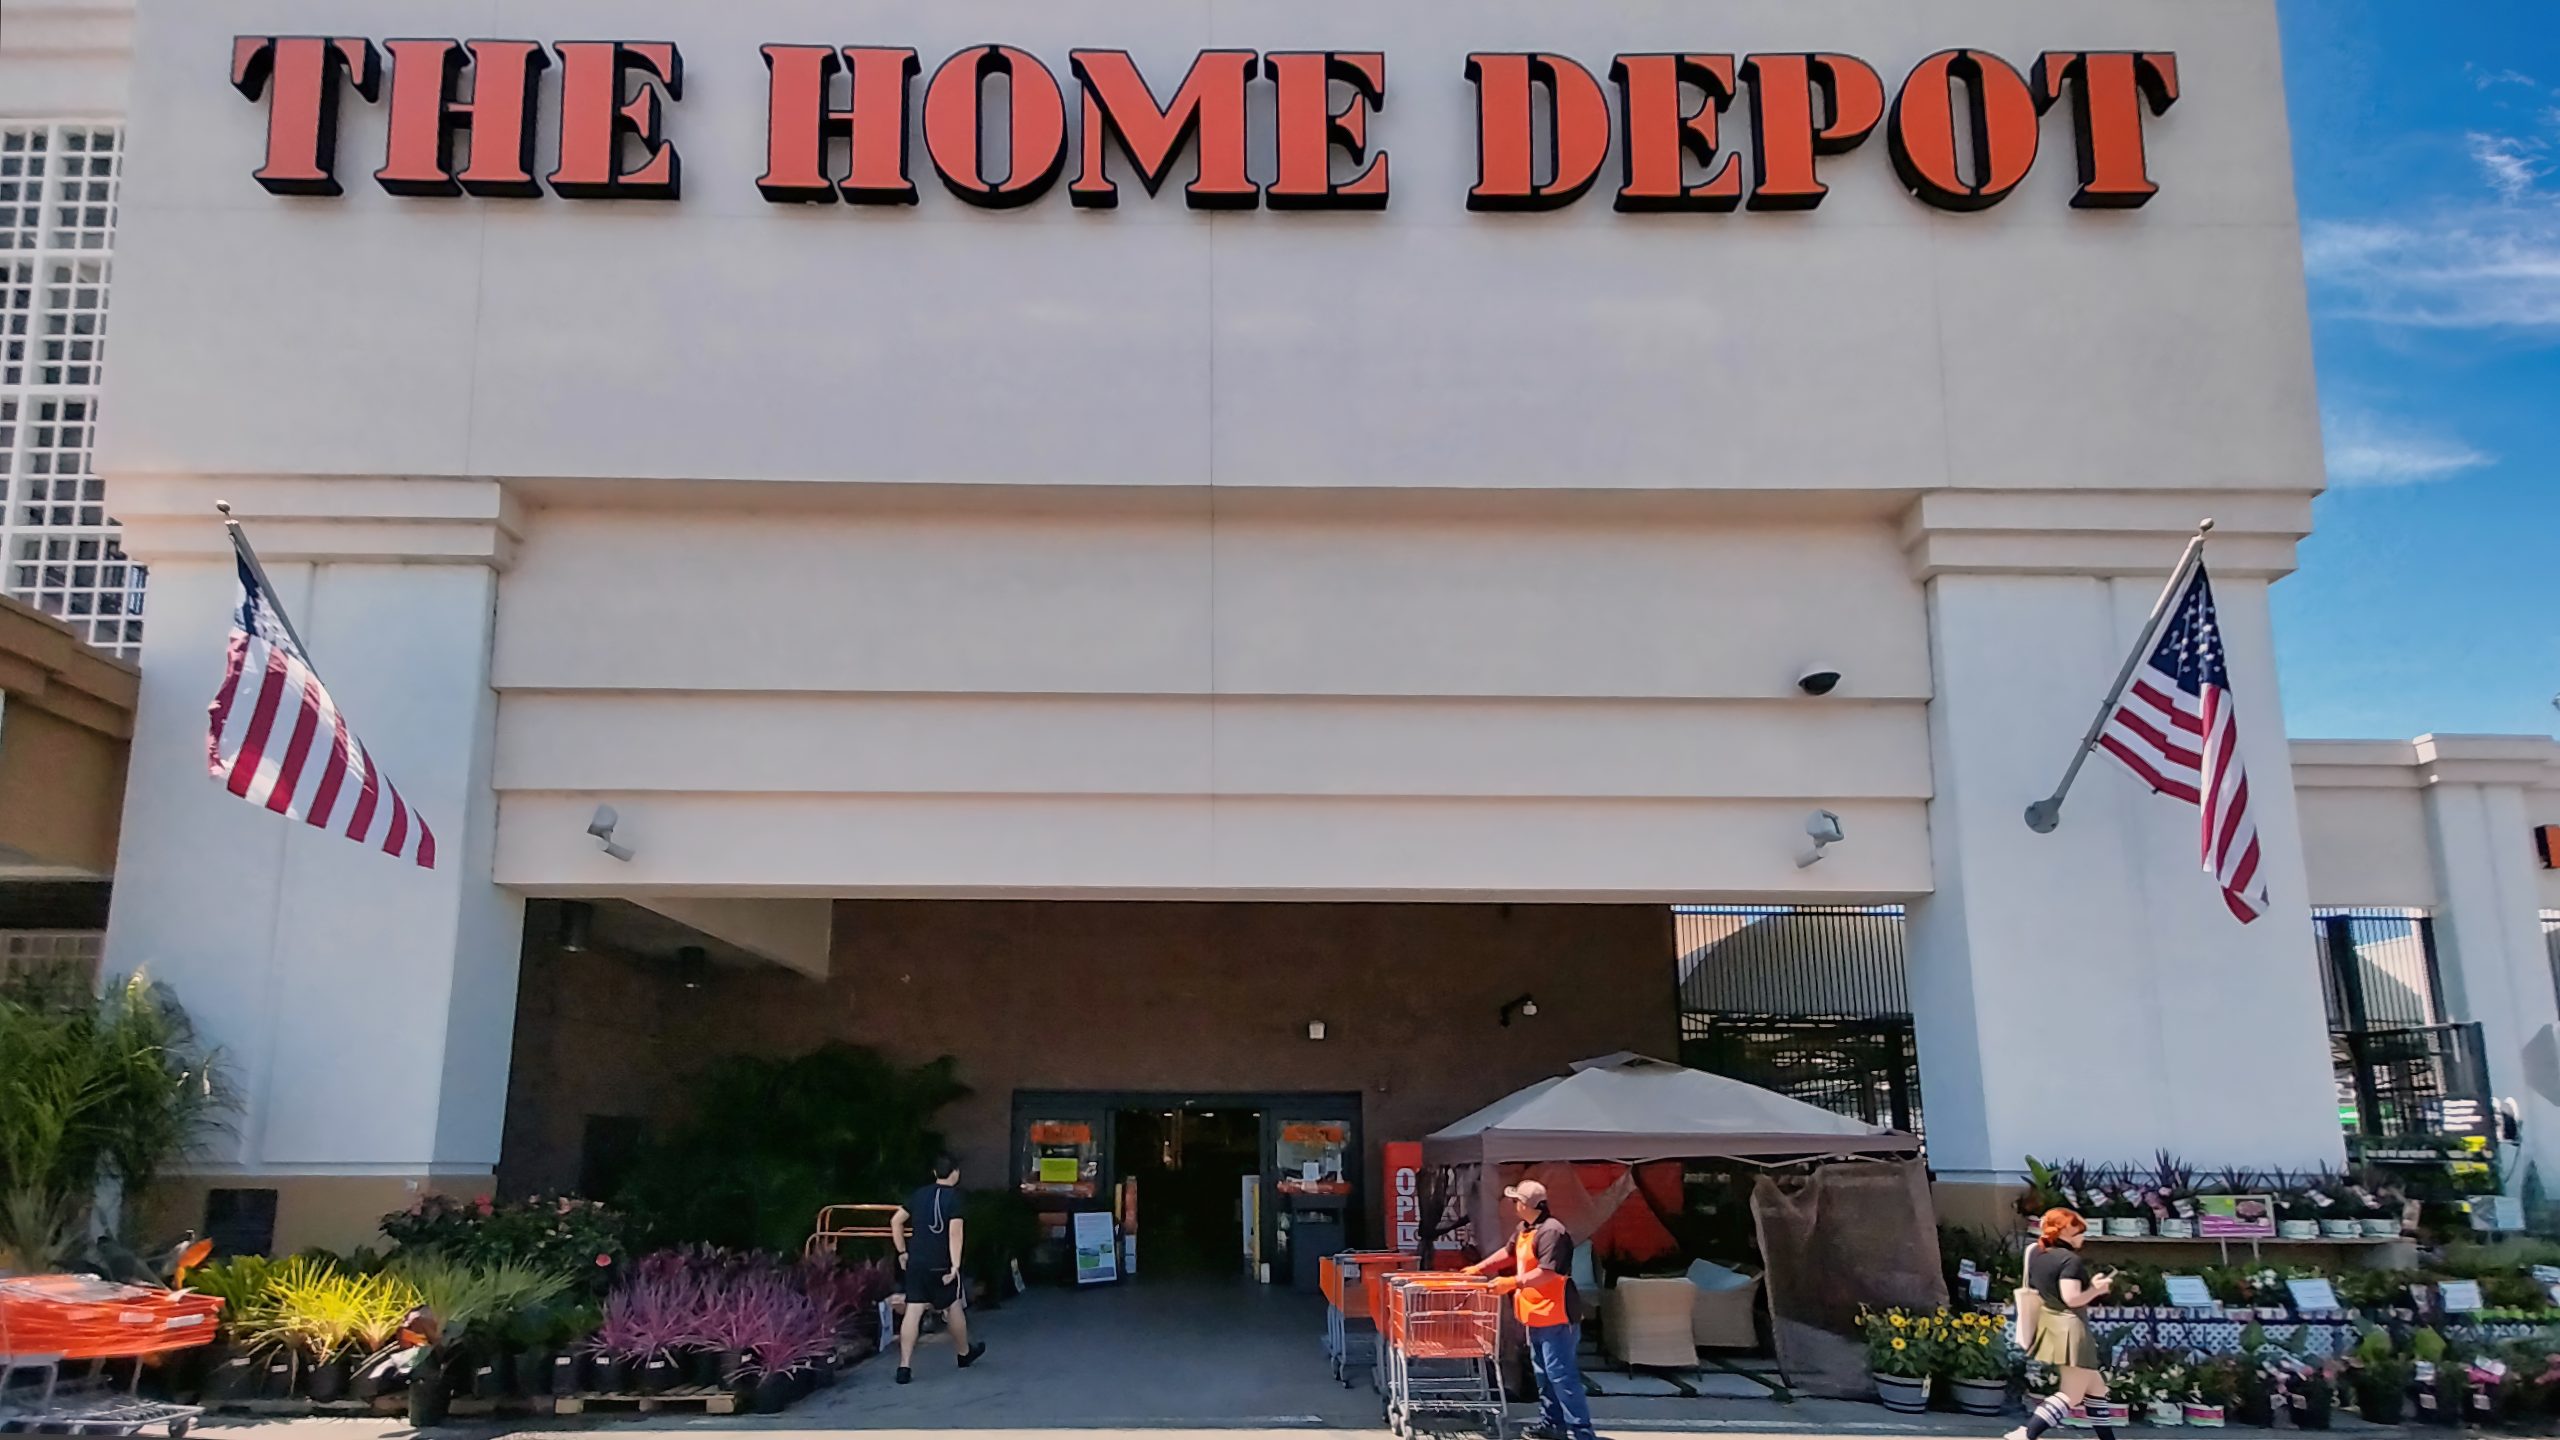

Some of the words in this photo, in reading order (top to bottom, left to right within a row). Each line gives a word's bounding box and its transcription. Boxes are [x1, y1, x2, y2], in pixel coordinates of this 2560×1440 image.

[231, 36, 683, 200] THE
[756, 43, 1389, 209] HOME
[1464, 48, 2180, 212] DEPOT
